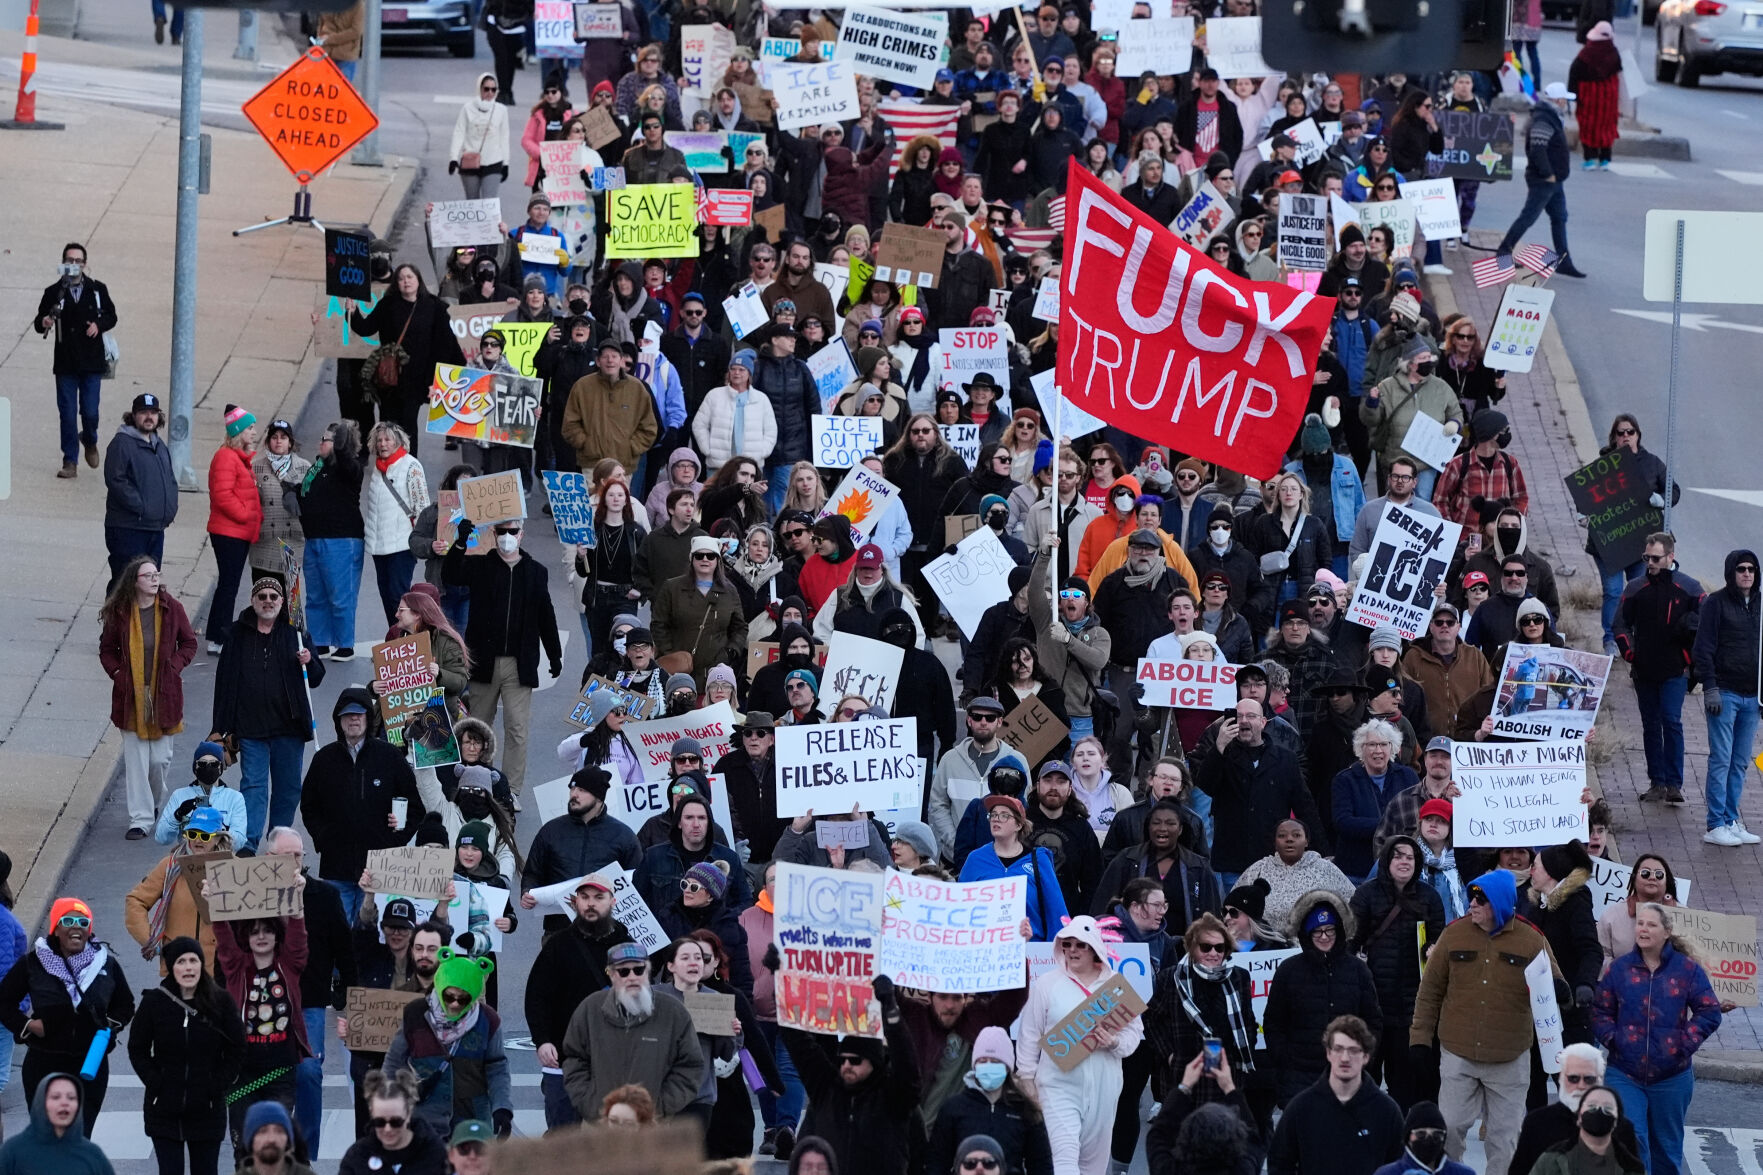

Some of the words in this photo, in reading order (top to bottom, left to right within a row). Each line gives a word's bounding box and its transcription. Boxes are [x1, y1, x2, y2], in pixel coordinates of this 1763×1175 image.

[537, 21, 574, 39] PEOP
[851, 12, 865, 23] ICE
[866, 13, 920, 36] ABDUCTIONS
[921, 27, 938, 39] ARE
[843, 27, 878, 47] HIGH
[881, 35, 938, 61] CRIMES
[684, 56, 702, 88] ICE
[854, 52, 893, 67] IMPEACH
[894, 61, 918, 74] NOW!
[787, 63, 842, 90] ICE
[287, 80, 339, 99] ROAD
[800, 86, 831, 103] ARE
[274, 103, 347, 124] CLOSED
[779, 100, 847, 122] CRIMINALS
[276, 129, 340, 148] AHEAD
[593, 166, 626, 190] USA
[447, 211, 487, 223] GOOD
[616, 191, 683, 221] SAVE
[612, 222, 693, 244] DEMOCRACY
[1281, 215, 1310, 229] JUSTICE
[1311, 218, 1325, 231] FOR
[334, 236, 368, 257] JUSTICE
[1280, 235, 1325, 247] RENEE
[1280, 245, 1304, 258] NICOLE
[1305, 247, 1325, 259] GOOD
[339, 266, 365, 286] GOOD
[1068, 186, 1316, 379] FUCK
[1506, 308, 1540, 321] MAGA
[953, 331, 998, 350] STOP
[1068, 306, 1277, 447] TRUMP
[431, 365, 488, 425] Love
[494, 384, 538, 427] FEAR
[825, 417, 870, 433] ICE
[820, 432, 865, 448] OUT
[868, 432, 880, 449] 4
[1574, 452, 1622, 486] STOP
[465, 475, 518, 500] Abolish
[541, 470, 587, 494] ICE
[855, 471, 891, 498] FACISM
[1588, 472, 1628, 503] ICE
[550, 492, 590, 504] AGENTS
[476, 499, 512, 521] ICE
[1587, 497, 1638, 529] Protect
[1386, 506, 1445, 557] BREAK
[1596, 510, 1662, 546] Democracy
[1404, 540, 1424, 552] THE
[930, 538, 1008, 595] FUCK
[1364, 541, 1448, 610] ICE
[1357, 594, 1424, 622] KIDNAPPING
[1358, 616, 1377, 628] FOR
[1360, 608, 1390, 622] MURDER
[1392, 616, 1419, 633] RING
[380, 641, 417, 662] THEY
[379, 655, 427, 681] BLAME
[1138, 662, 1236, 685] ABOLIS
[387, 694, 402, 709] SO
[403, 687, 432, 707] YOU
[1170, 687, 1213, 707] ICE
[1017, 703, 1050, 736] ICE
[1494, 720, 1552, 737] ABOLISH
[1560, 727, 1584, 740] ICE
[640, 729, 681, 747] HUMAN
[683, 722, 725, 739] RIGHTS
[806, 725, 903, 756] RELEASE
[1537, 745, 1585, 765] MIGRA
[781, 762, 833, 789] FILES
[853, 753, 916, 783] LEAKS
[1460, 775, 1482, 791] NO
[1491, 774, 1535, 790] HUMAN
[1541, 771, 1577, 786] BEING
[623, 784, 663, 813] ICE
[1484, 796, 1499, 809] IS
[1504, 793, 1560, 809] ILLEGAL
[1469, 817, 1495, 837] ON
[1502, 817, 1546, 836] STOLEN
[209, 861, 284, 889] FUCK
[428, 867, 445, 876] on
[886, 874, 1016, 903] ABOLISH
[788, 873, 874, 931] ICE
[882, 909, 1014, 946] PROSECUTE
[916, 904, 989, 928] ICE
[1672, 911, 1712, 932] THIS
[629, 923, 649, 939] ZIS
[779, 925, 818, 947] melts
[822, 931, 852, 948] when
[855, 937, 872, 948] we
[784, 948, 824, 974] TURN
[825, 951, 844, 975] UP
[844, 951, 874, 977] THE
[881, 959, 936, 975] THOMAS
[941, 963, 995, 975] GORSUCH
[895, 971, 940, 989] AND
[944, 974, 1020, 991] MILLER
[1712, 980, 1756, 996] HANDS
[783, 975, 873, 1034] HEAT
[348, 1012, 401, 1033] CONTA
[1047, 989, 1118, 1058] SILENCE
[1080, 1003, 1136, 1053] DATH
